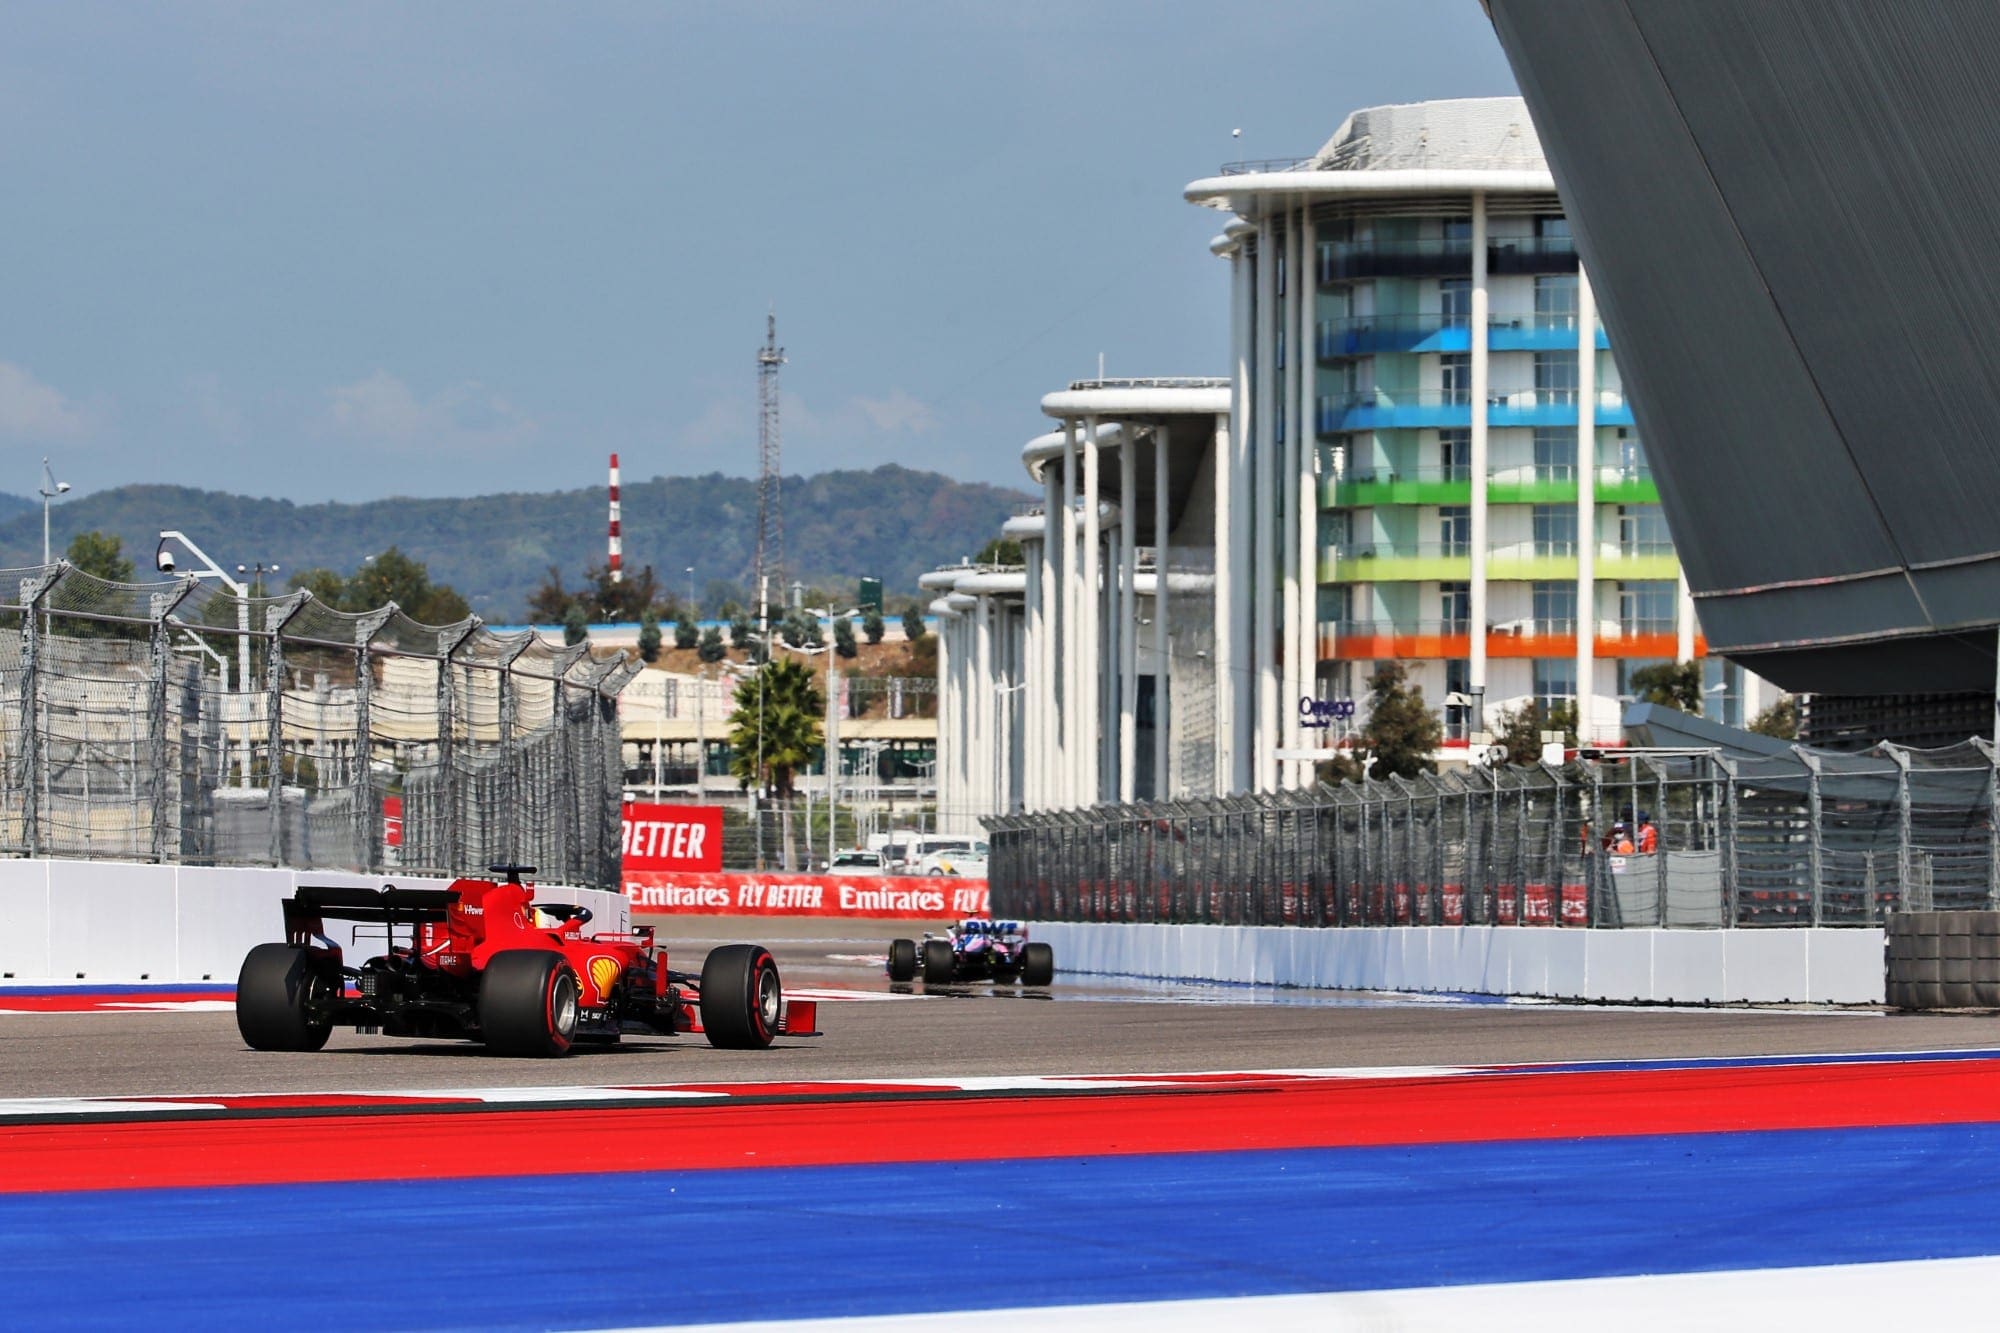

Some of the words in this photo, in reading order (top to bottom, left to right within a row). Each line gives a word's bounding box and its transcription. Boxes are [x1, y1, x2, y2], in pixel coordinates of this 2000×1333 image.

[626, 882, 730, 907] Emirates
[737, 884, 765, 907] FLY
[766, 885, 824, 909] BETTER
[839, 886, 945, 911] Emirates
[952, 888, 983, 912] FLY
[969, 921, 1018, 935] BWT
